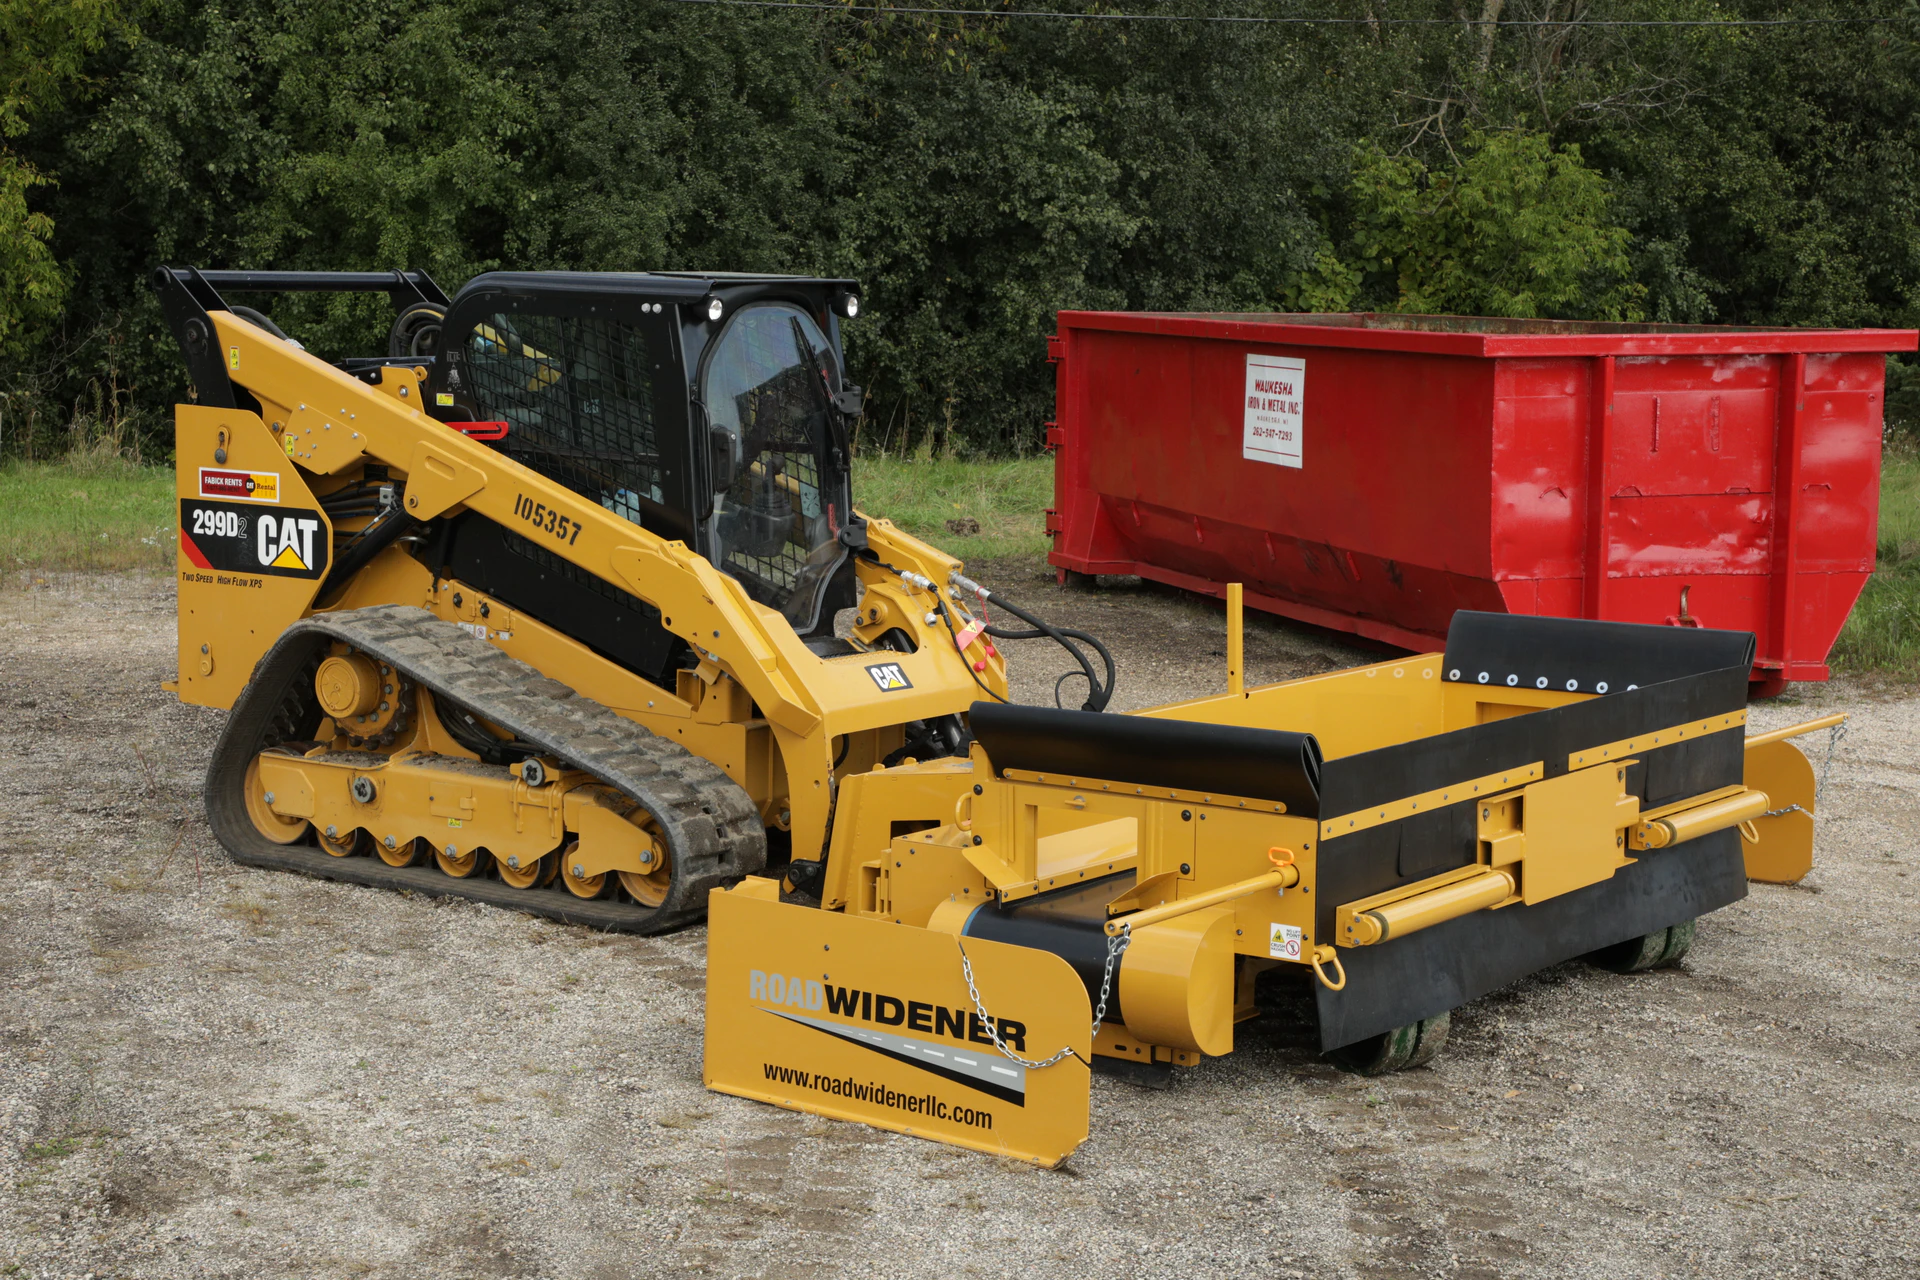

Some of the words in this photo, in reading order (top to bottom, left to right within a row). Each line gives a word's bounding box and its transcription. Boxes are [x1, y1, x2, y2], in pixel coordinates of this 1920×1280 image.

[1255, 379, 1293, 396] WAUKESHA
[1247, 396, 1260, 410] IRON
[1262, 398, 1266, 411] &
[1268, 399, 1286, 413] METAL
[1252, 426, 1293, 442] 262-547-7293
[204, 476, 224, 486] FABICK
[224, 478, 243, 487] RENTS
[246, 482, 255, 490] CAT
[256, 482, 276, 491] Rental
[192, 509, 248, 539] 299D2
[514, 493, 582, 546] 105357
[257, 514, 318, 571] CAT
[195, 573, 214, 584] SPEED
[231, 576, 249, 587] FLOW
[249, 578, 263, 589] XPS
[870, 665, 907, 689] CAT
[763, 1063, 993, 1130] www.roadwidenerllc.com
